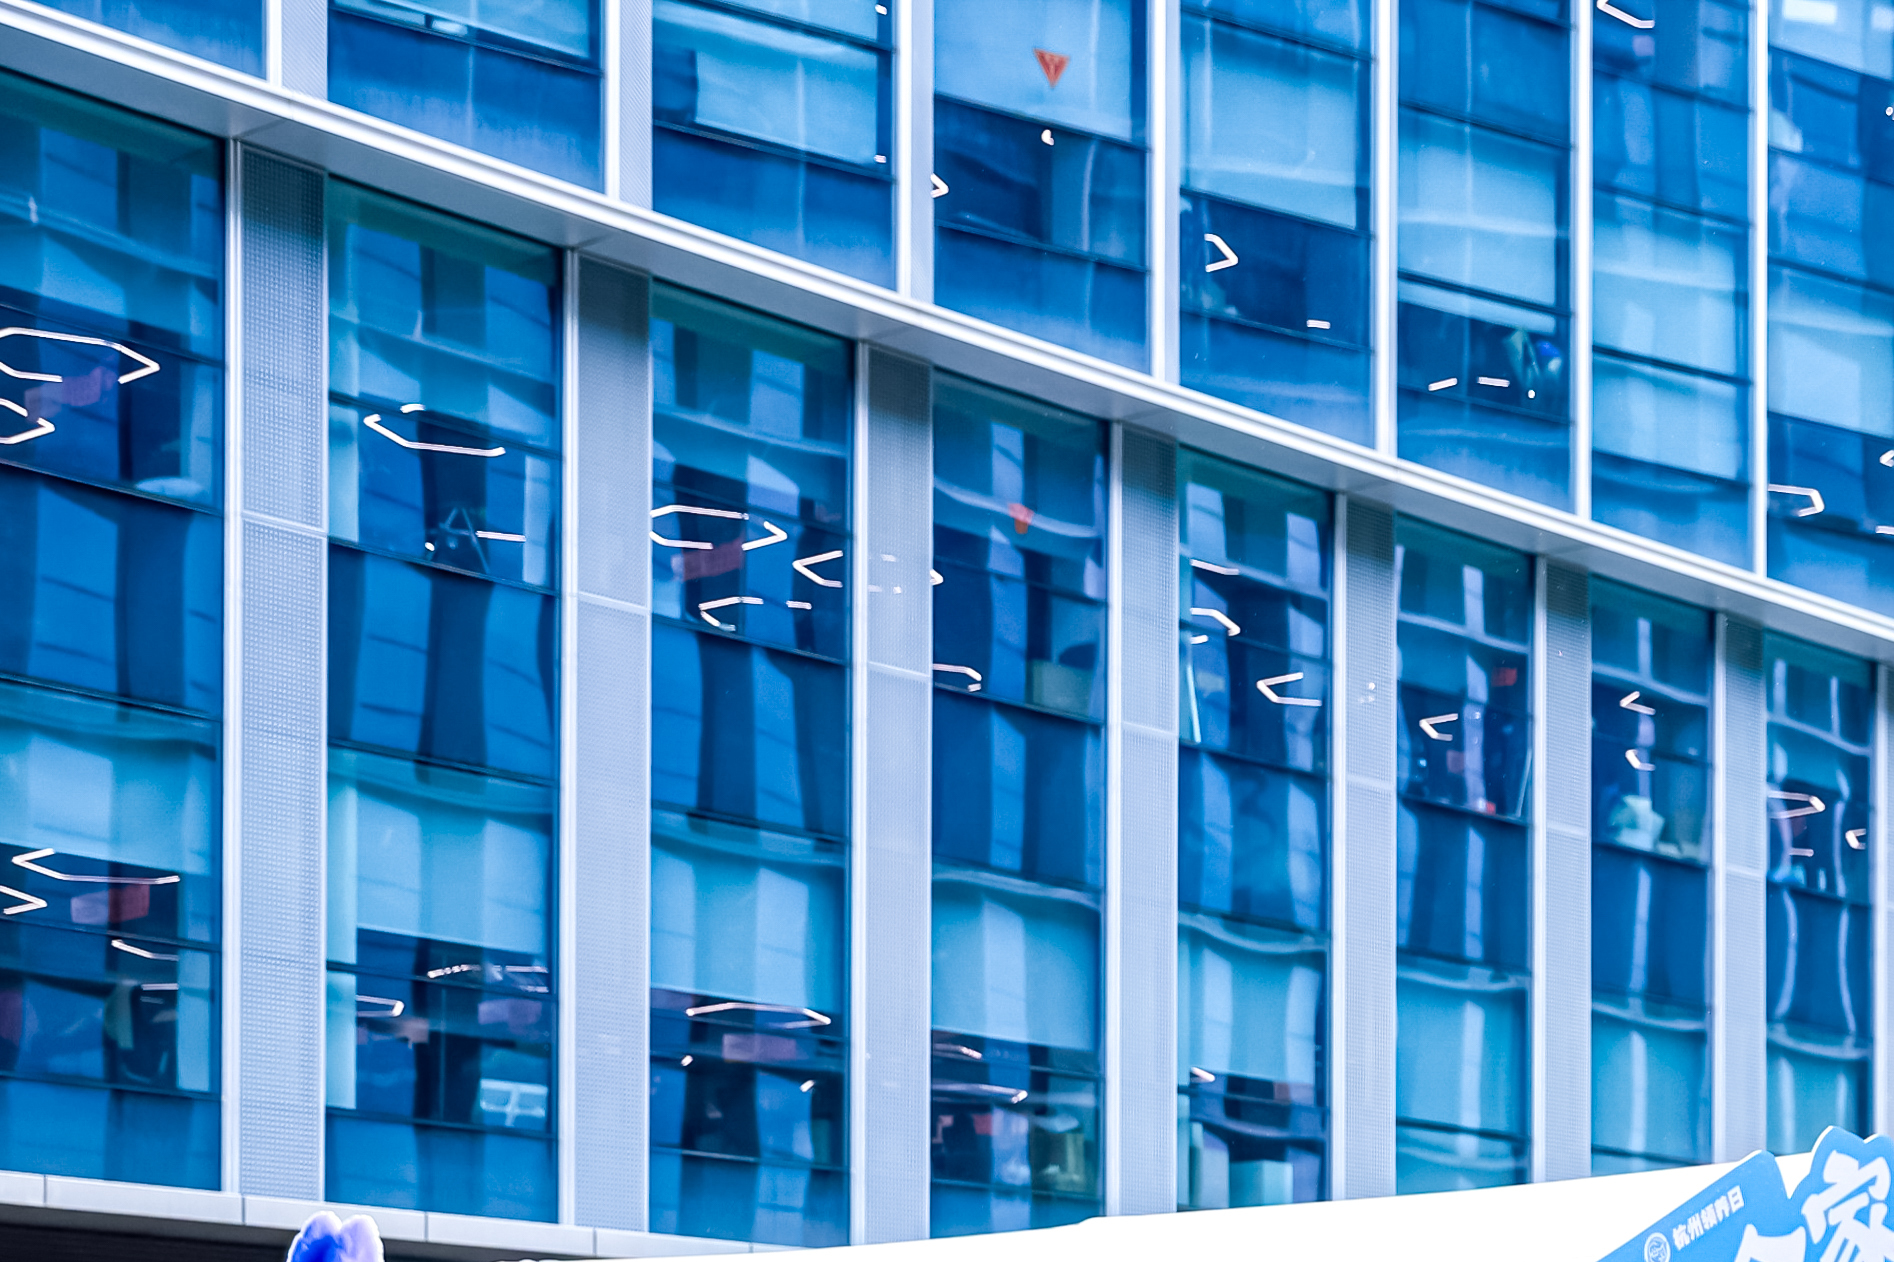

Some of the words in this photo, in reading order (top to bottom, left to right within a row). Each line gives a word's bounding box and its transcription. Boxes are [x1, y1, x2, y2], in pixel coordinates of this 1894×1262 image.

[1673, 1185, 1744, 1251] 杭州领养日
